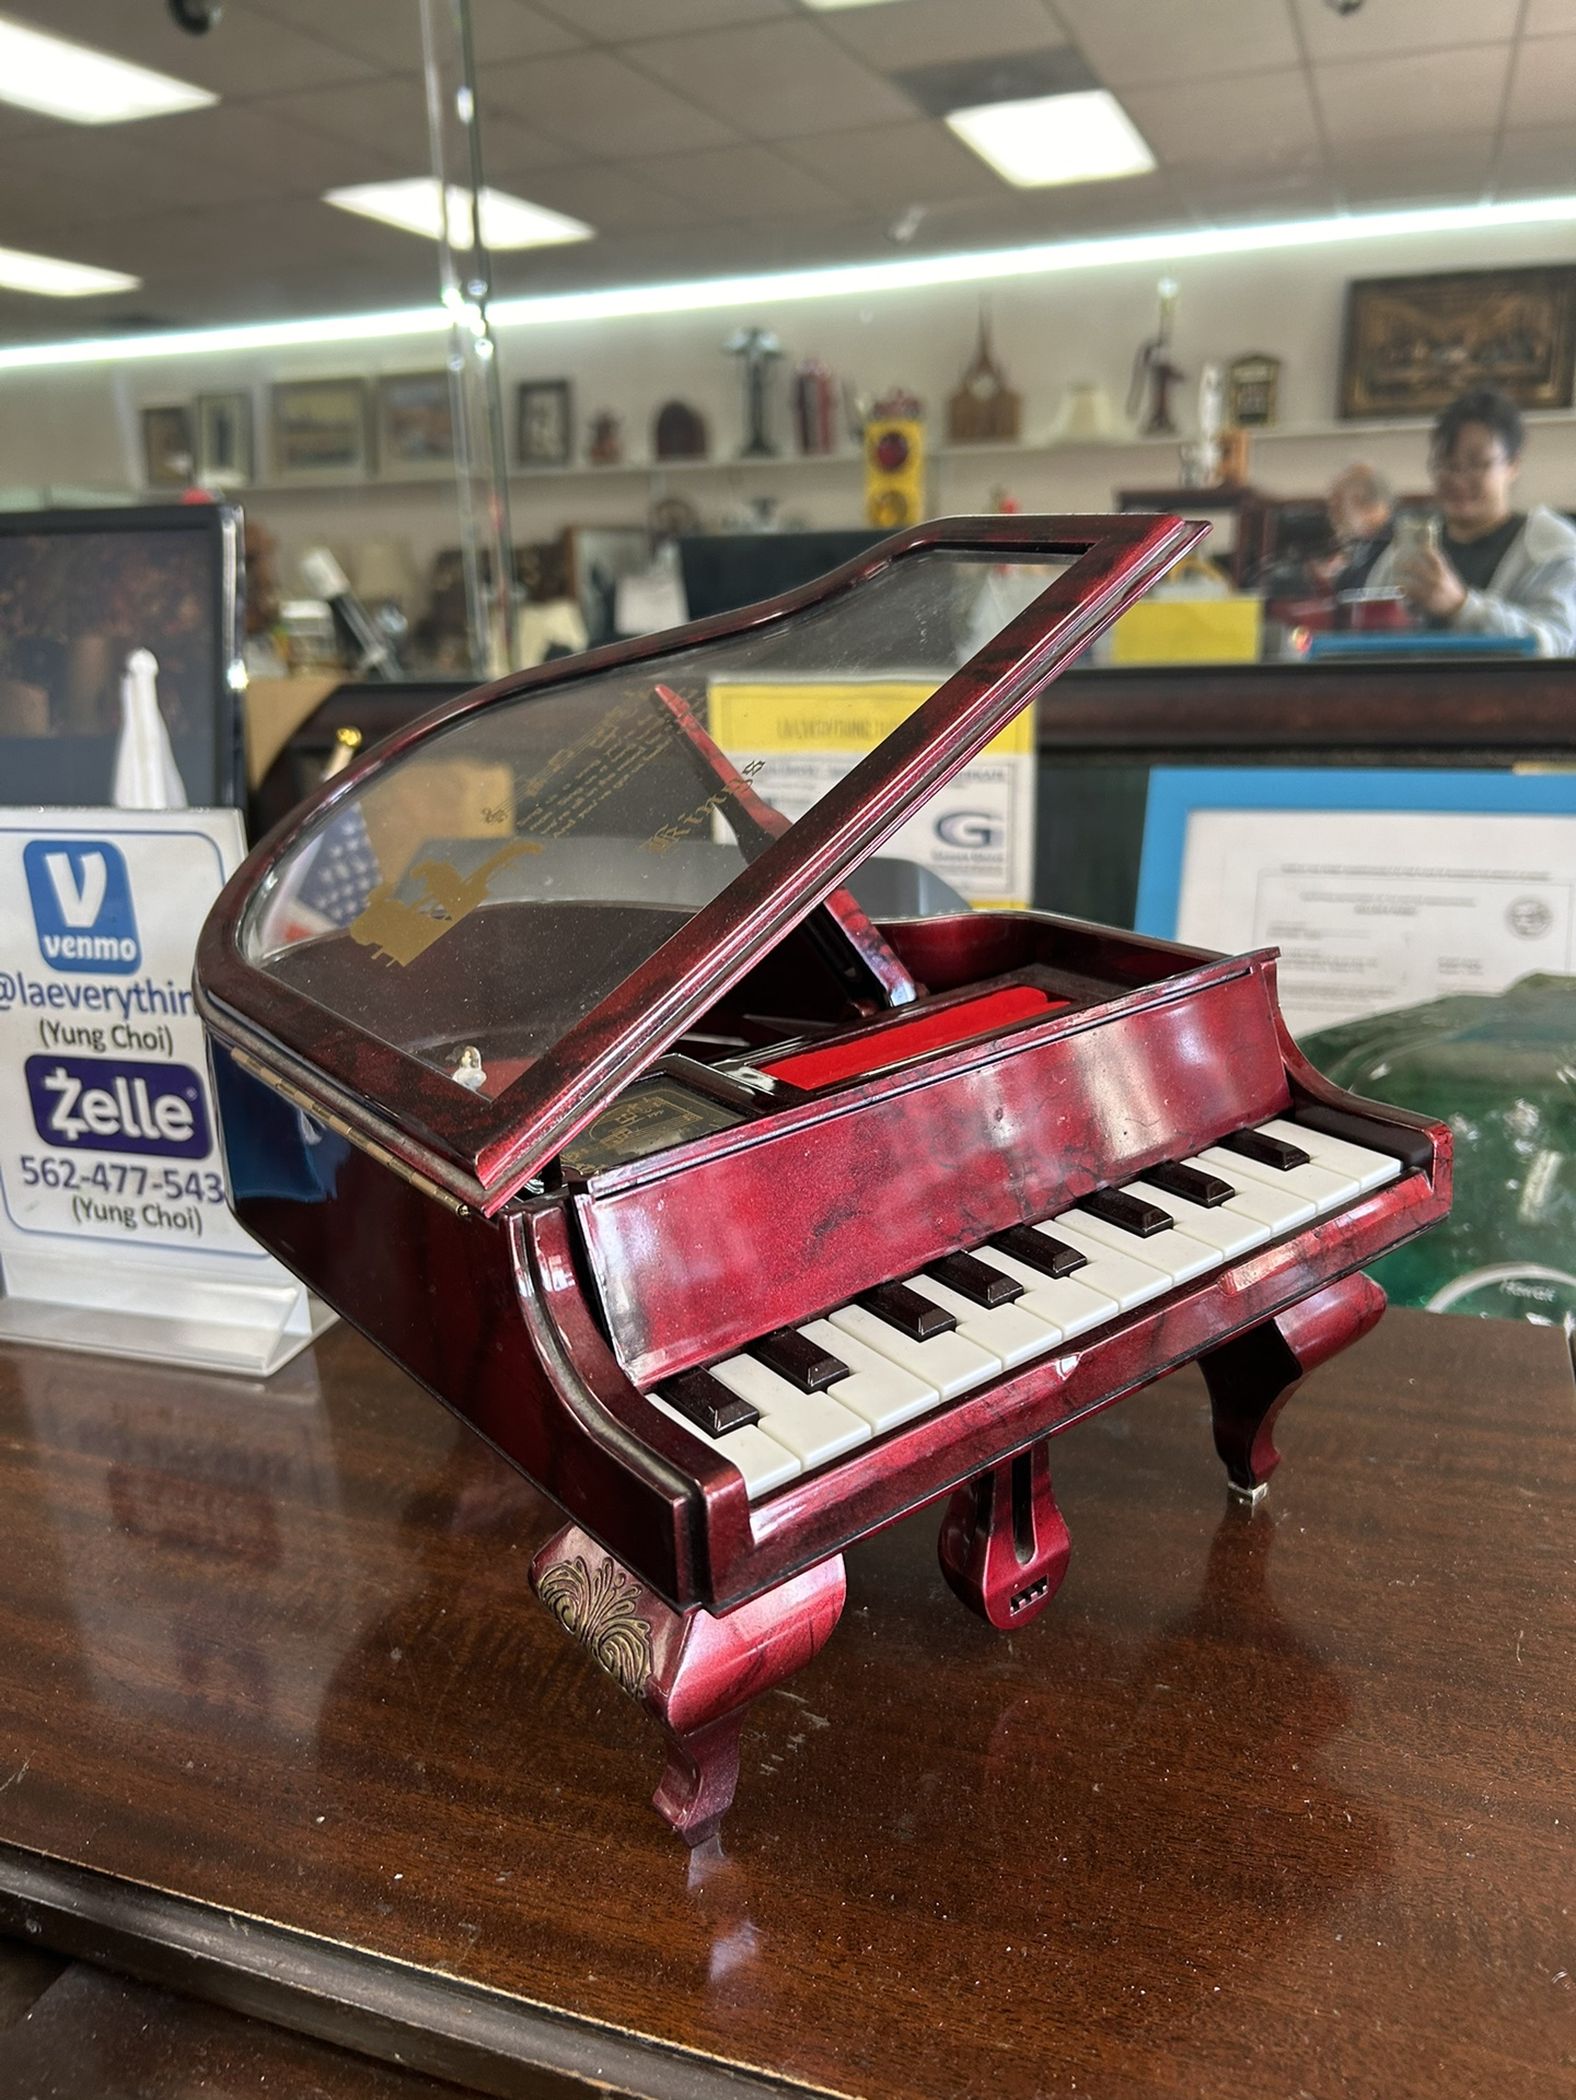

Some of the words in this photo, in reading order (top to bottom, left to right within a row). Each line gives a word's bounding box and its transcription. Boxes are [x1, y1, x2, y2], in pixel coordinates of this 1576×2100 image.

[43, 934, 137, 962] venmo
[40, 1018, 106, 1053] (Yung
[111, 1024, 173, 1057] Choi)
[44, 1066, 195, 1142] Zelle
[72, 1196, 137, 1229] (Yung
[142, 1202, 202, 1236] Choi)
